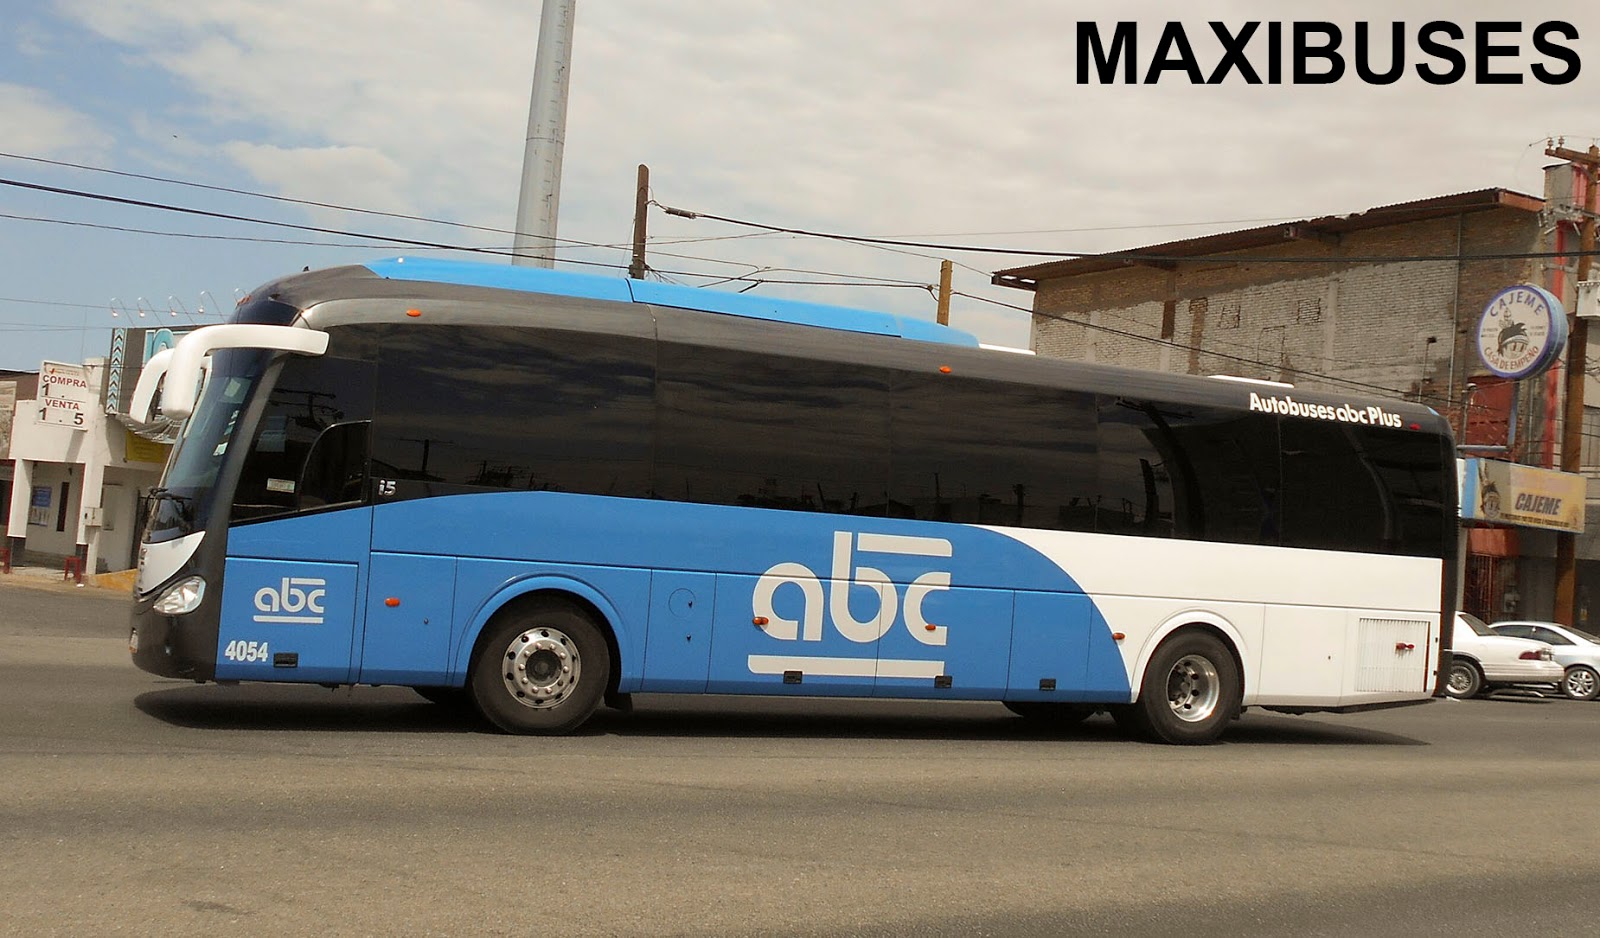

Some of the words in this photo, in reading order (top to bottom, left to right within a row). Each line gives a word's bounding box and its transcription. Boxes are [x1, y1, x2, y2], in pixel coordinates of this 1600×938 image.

[1491, 291, 1544, 317] CAJEME
[43, 374, 87, 388] COMPRA
[45, 398, 80, 411] VENTA
[1250, 392, 1336, 420] Autobuses
[1336, 403, 1369, 424] abc
[1367, 406, 1402, 428] Plus
[1515, 493, 1562, 515] CAJEME
[254, 577, 326, 614] abc
[752, 530, 952, 646] abc
[225, 640, 268, 662] 4054
